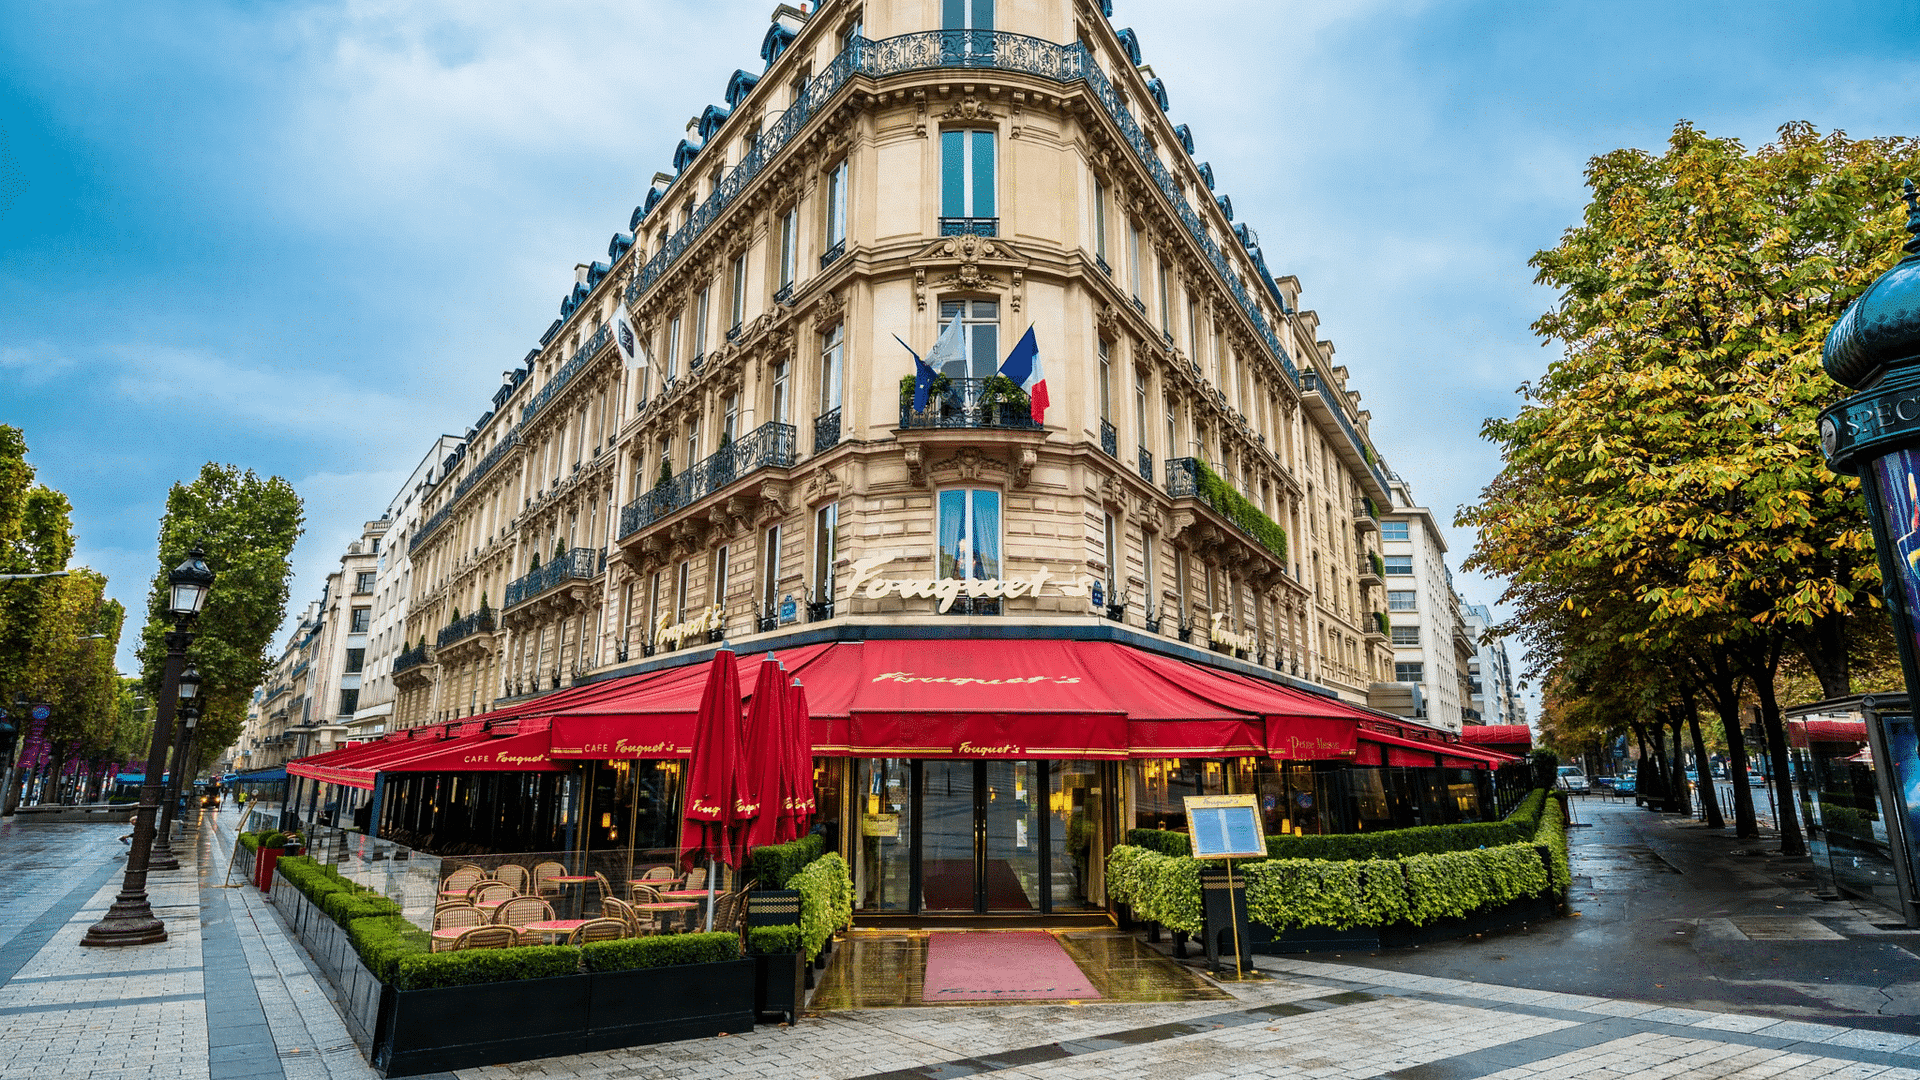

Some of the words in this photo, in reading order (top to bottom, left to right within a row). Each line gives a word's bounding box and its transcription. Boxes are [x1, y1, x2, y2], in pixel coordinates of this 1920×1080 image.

[1846, 396, 1920, 437] SPEC
[847, 554, 1094, 614] Fouquet's
[872, 671, 1081, 686] Fouquet's
[584, 743, 609, 753] CAFE
[615, 738, 675, 758] Fouquet's
[959, 741, 1021, 756] Fouquet's
[464, 754, 490, 763] CAFE
